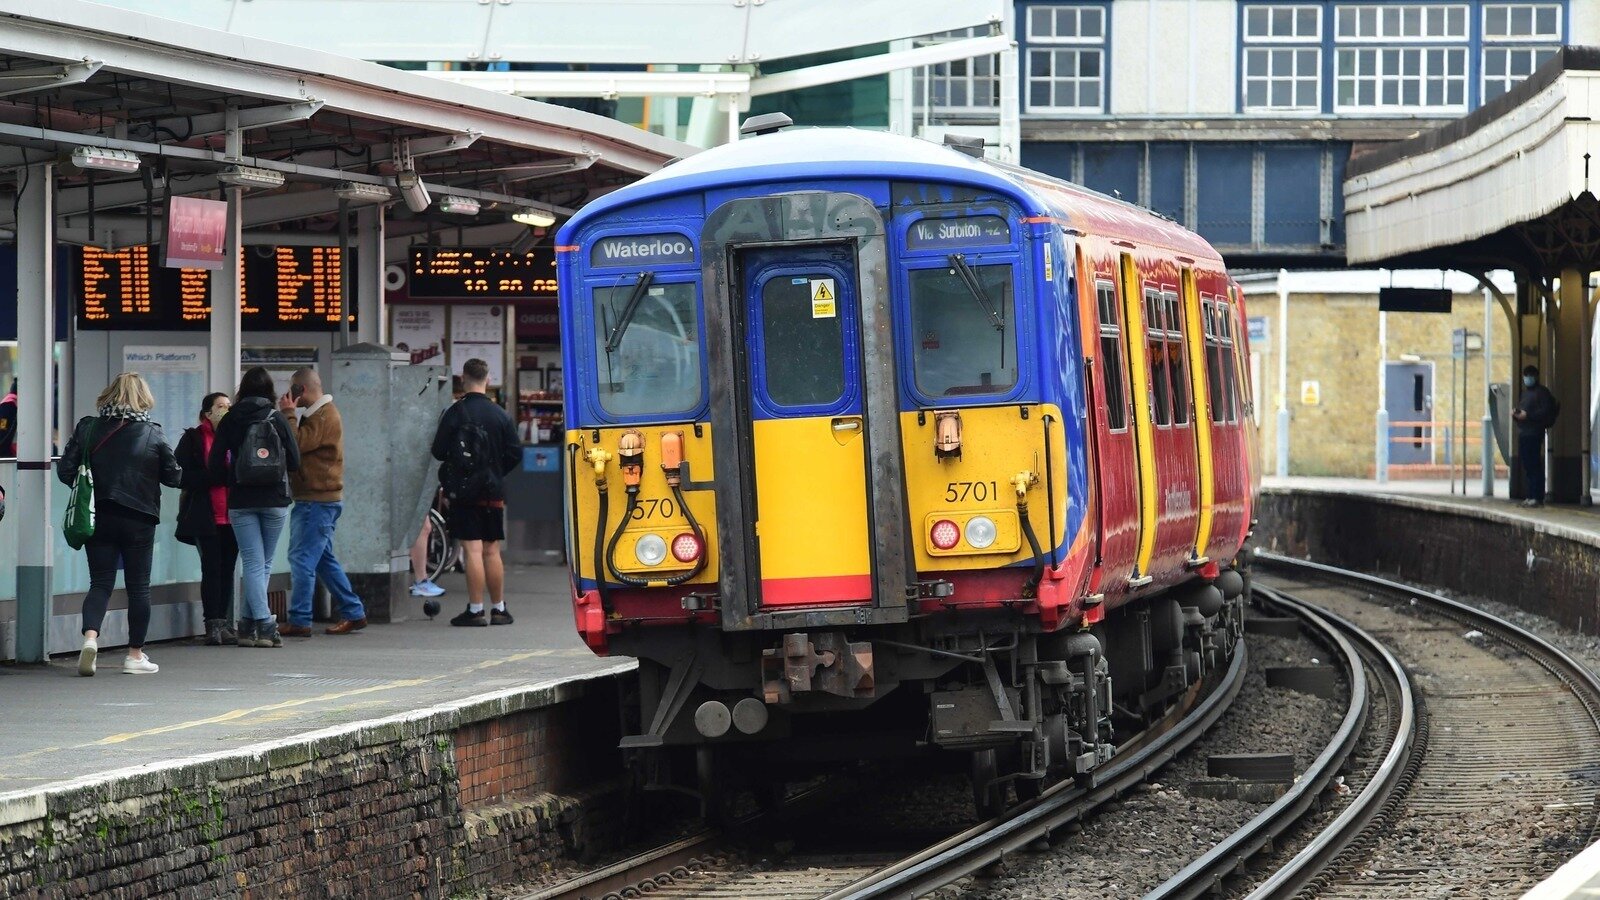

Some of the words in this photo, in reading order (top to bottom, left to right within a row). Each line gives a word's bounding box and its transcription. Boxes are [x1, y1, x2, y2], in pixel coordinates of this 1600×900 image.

[917, 225, 934, 240] Via
[939, 223, 981, 240] Surbiton
[603, 240, 686, 258] Waterloo
[125, 352, 152, 361] Which
[155, 352, 197, 361] Platform?
[945, 481, 997, 502] 5701
